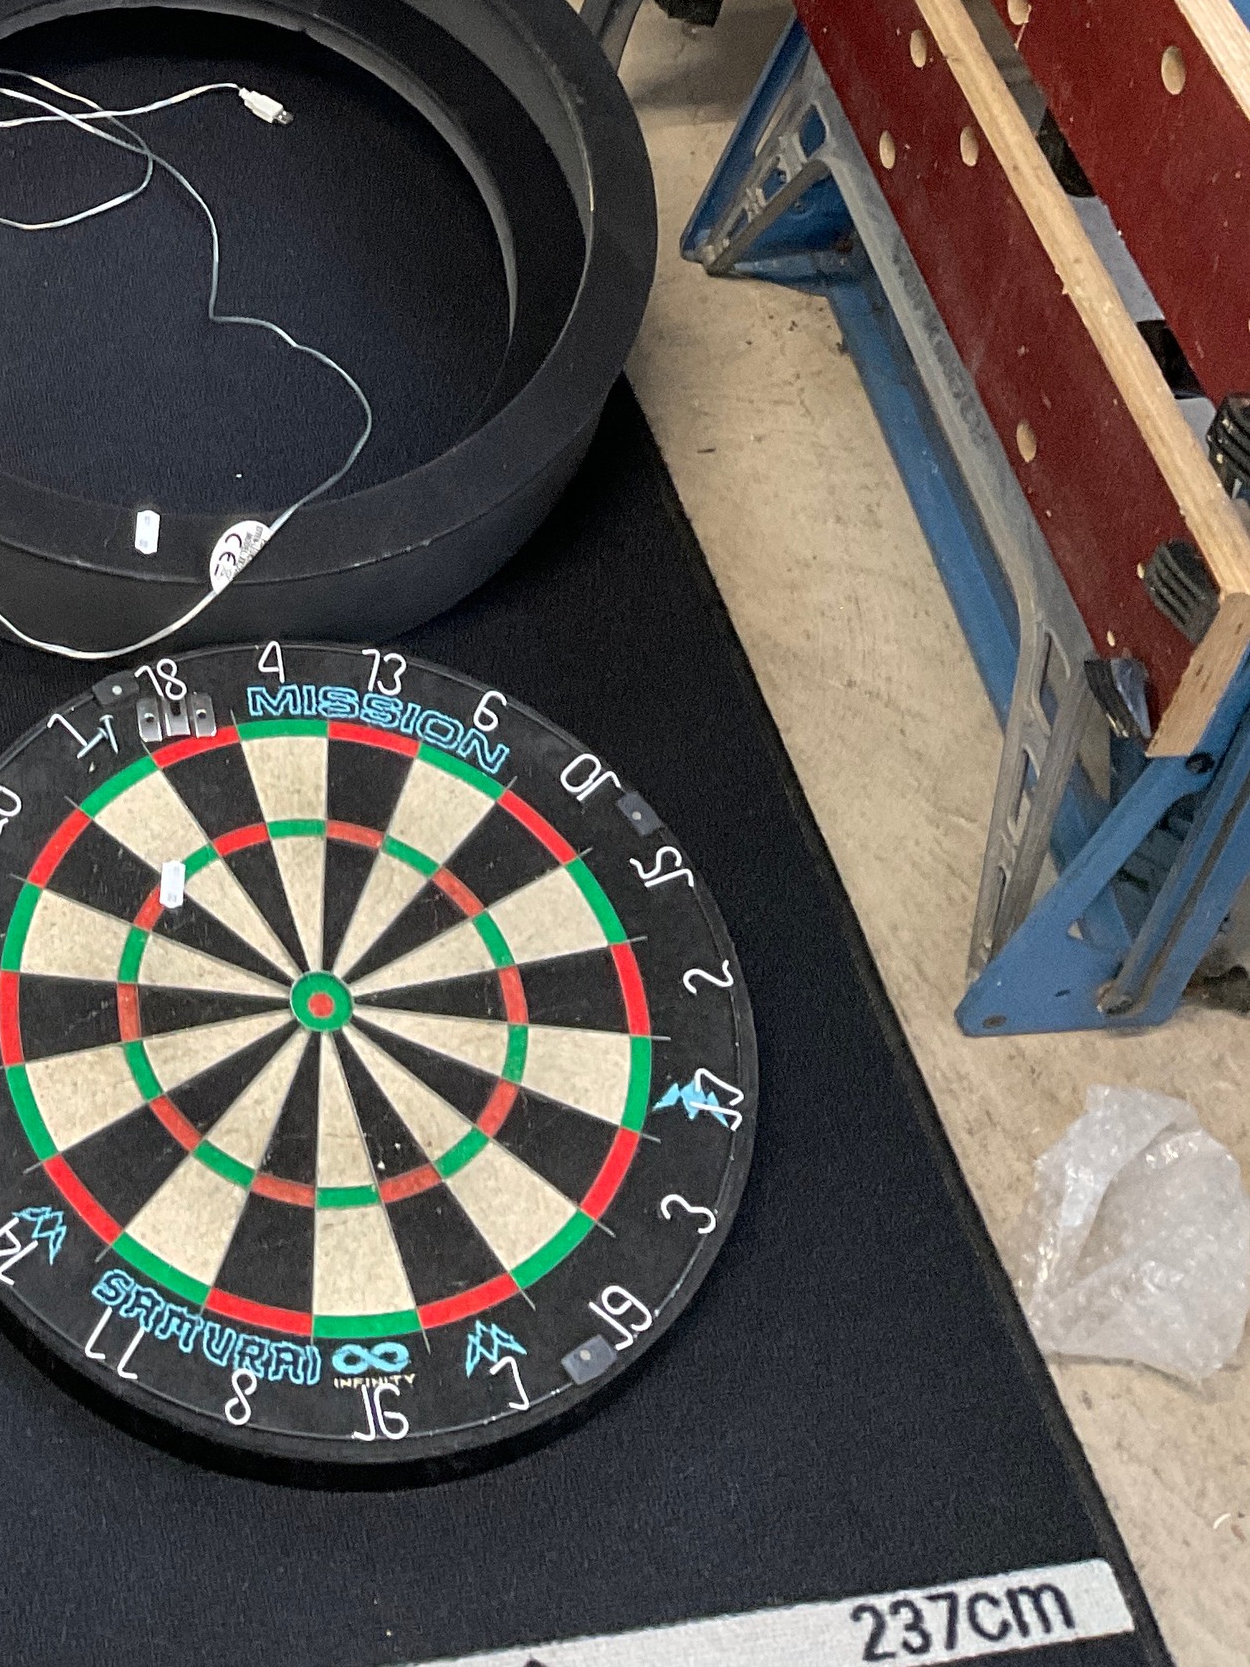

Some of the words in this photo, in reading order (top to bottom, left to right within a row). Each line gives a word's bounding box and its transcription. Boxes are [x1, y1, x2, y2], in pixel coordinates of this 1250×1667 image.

[134, 658, 188, 701] 18
[257, 640, 285, 684] 4
[361, 648, 407, 696] 13
[47, 713, 88, 747] 1
[246, 684, 511, 774] MISSION
[472, 690, 508, 732] 6
[560, 753, 622, 802] 10
[629, 846, 695, 888] 15
[682, 959, 734, 996] 2
[689, 1067, 745, 1132] 17
[660, 1193, 717, 1234] 3
[91, 1268, 323, 1386] SAMURAI
[588, 1285, 653, 1351] 19
[224, 1368, 258, 1426] 8
[333, 1372, 417, 1389] INFINITY
[350, 1384, 411, 1442] 16
[850, 1584, 1076, 1662] 237cm
